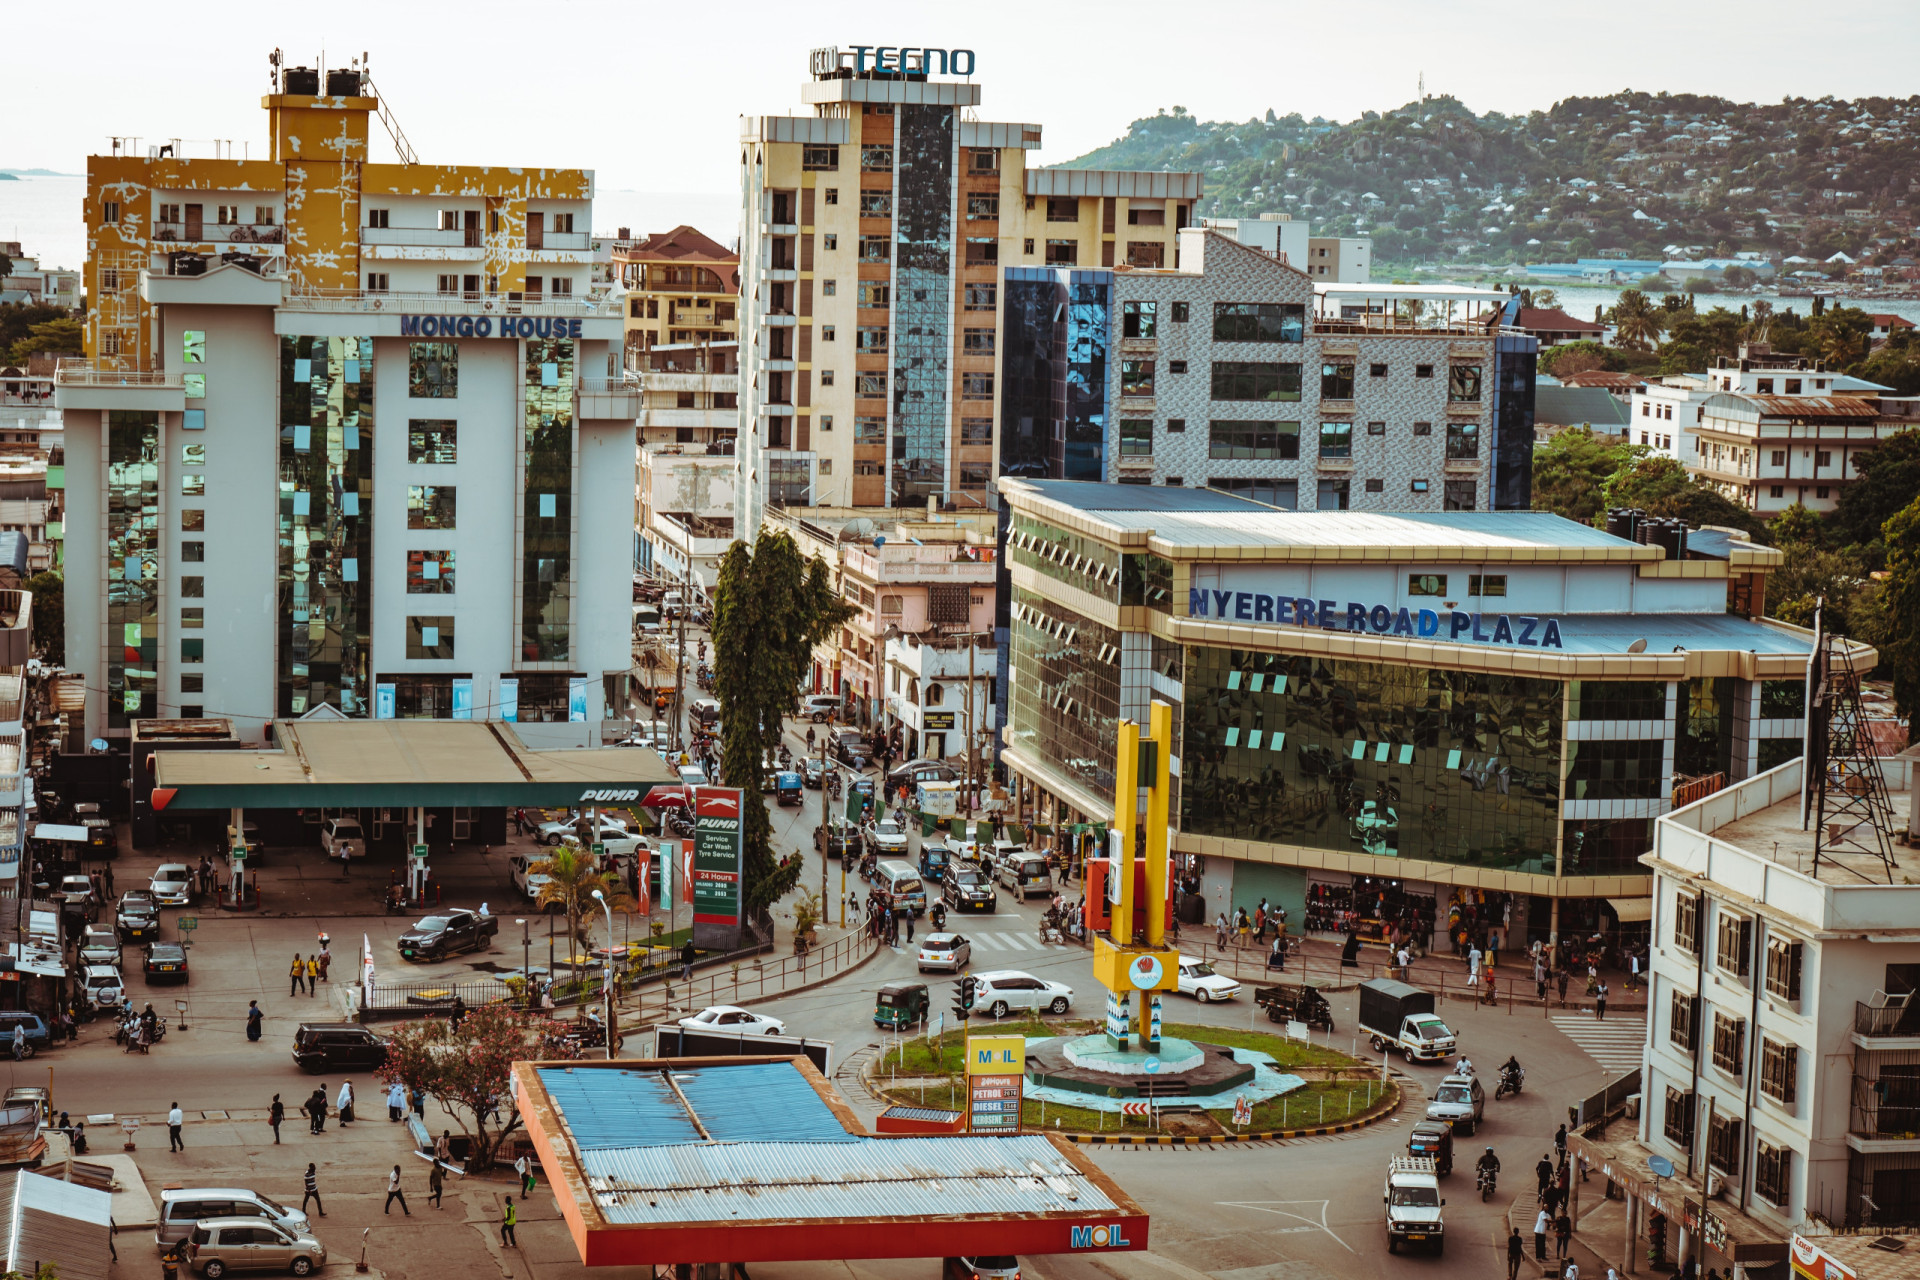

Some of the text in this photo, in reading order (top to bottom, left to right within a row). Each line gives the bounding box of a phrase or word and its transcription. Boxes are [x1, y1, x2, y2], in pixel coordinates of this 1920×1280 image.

[849, 45, 976, 76] TECNO
[401, 315, 582, 339] MONGO HOUSE
[1189, 587, 1563, 649] NYERERE ROAD PLAZA
[580, 789, 640, 802] PUMA
[697, 818, 739, 830] PUMA
[705, 834, 729, 843] Service
[712, 850, 735, 859] Service
[711, 873, 732, 881] Hours
[973, 1089, 1001, 1098] PETROL
[973, 1102, 1002, 1111] DIESEL
[973, 1114, 1003, 1125] KEROSENE
[1071, 1224, 1131, 1248] MOIL
[1795, 1236, 1813, 1254] Coral
